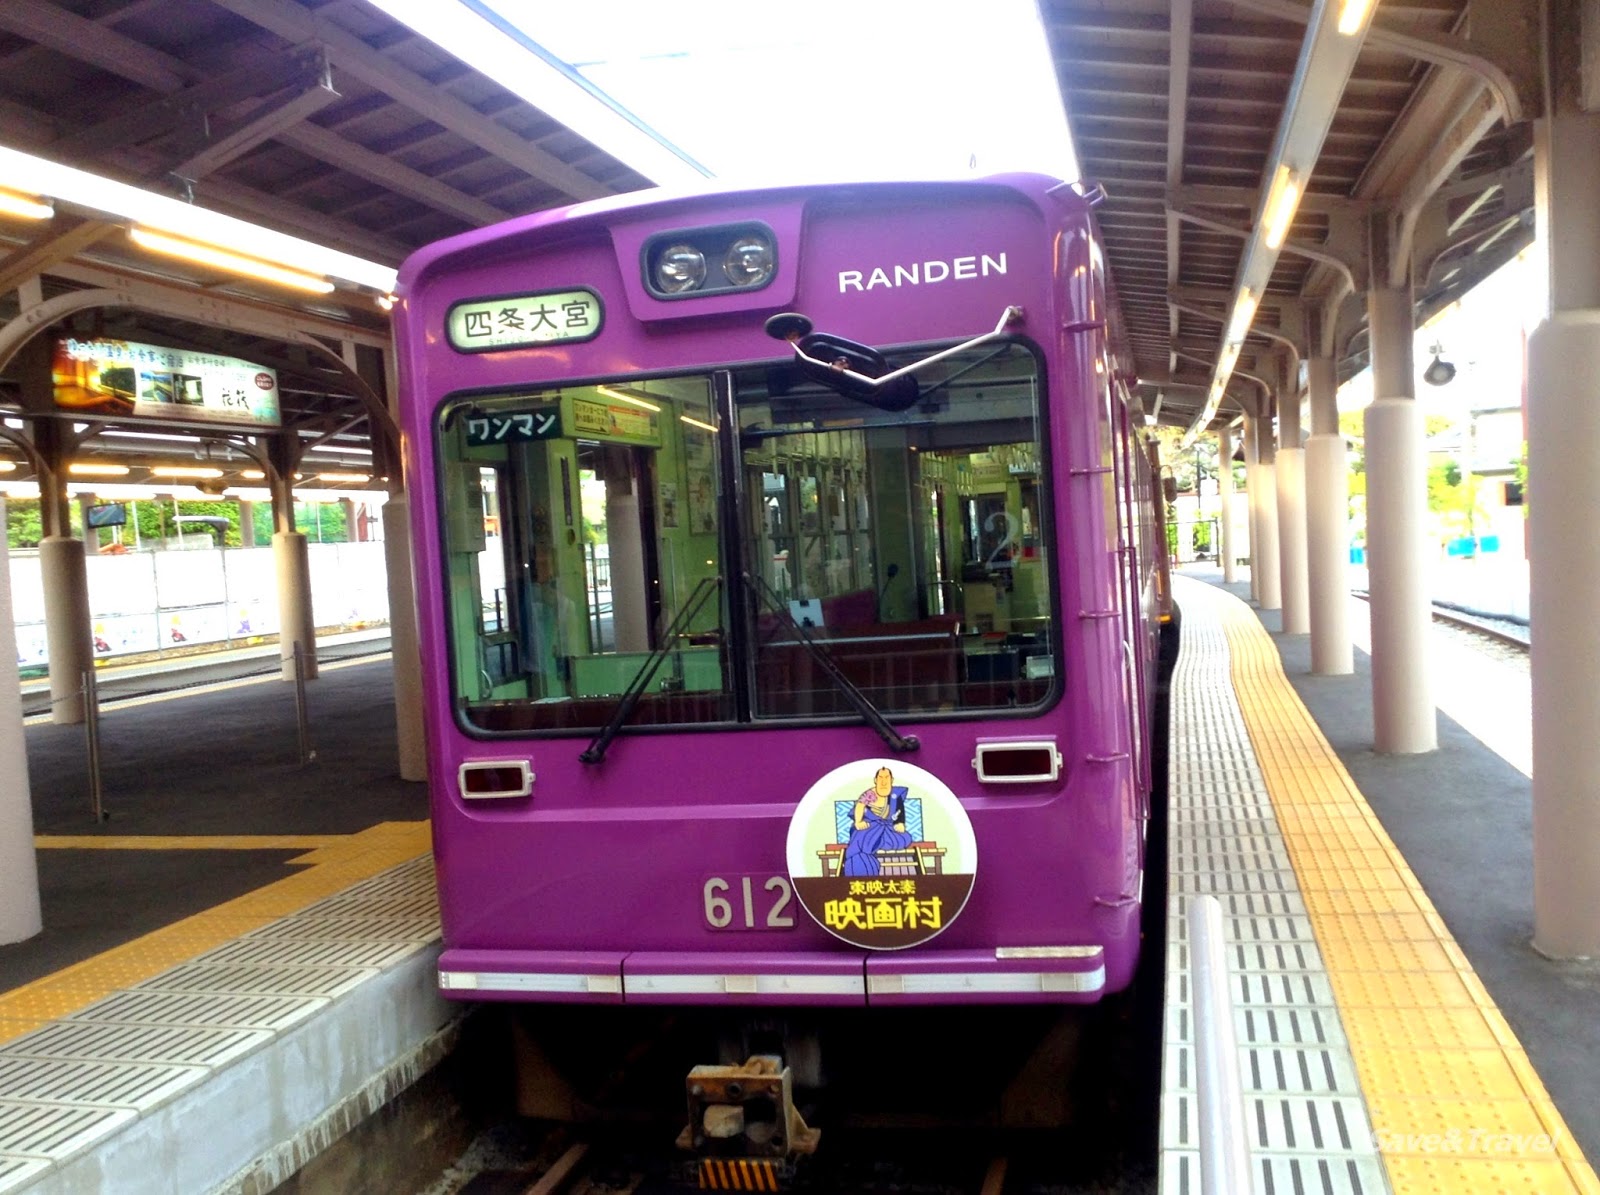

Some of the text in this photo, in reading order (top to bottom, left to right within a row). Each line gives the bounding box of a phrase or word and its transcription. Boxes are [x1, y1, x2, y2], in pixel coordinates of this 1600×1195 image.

[838, 252, 1008, 294] RANDEN
[464, 300, 591, 338] 四条大宮
[468, 413, 556, 441] ワンマン
[984, 511, 1020, 575] 2
[703, 876, 794, 929] 612
[849, 879, 916, 896] 東映太秦
[823, 895, 943, 930] 映画村
